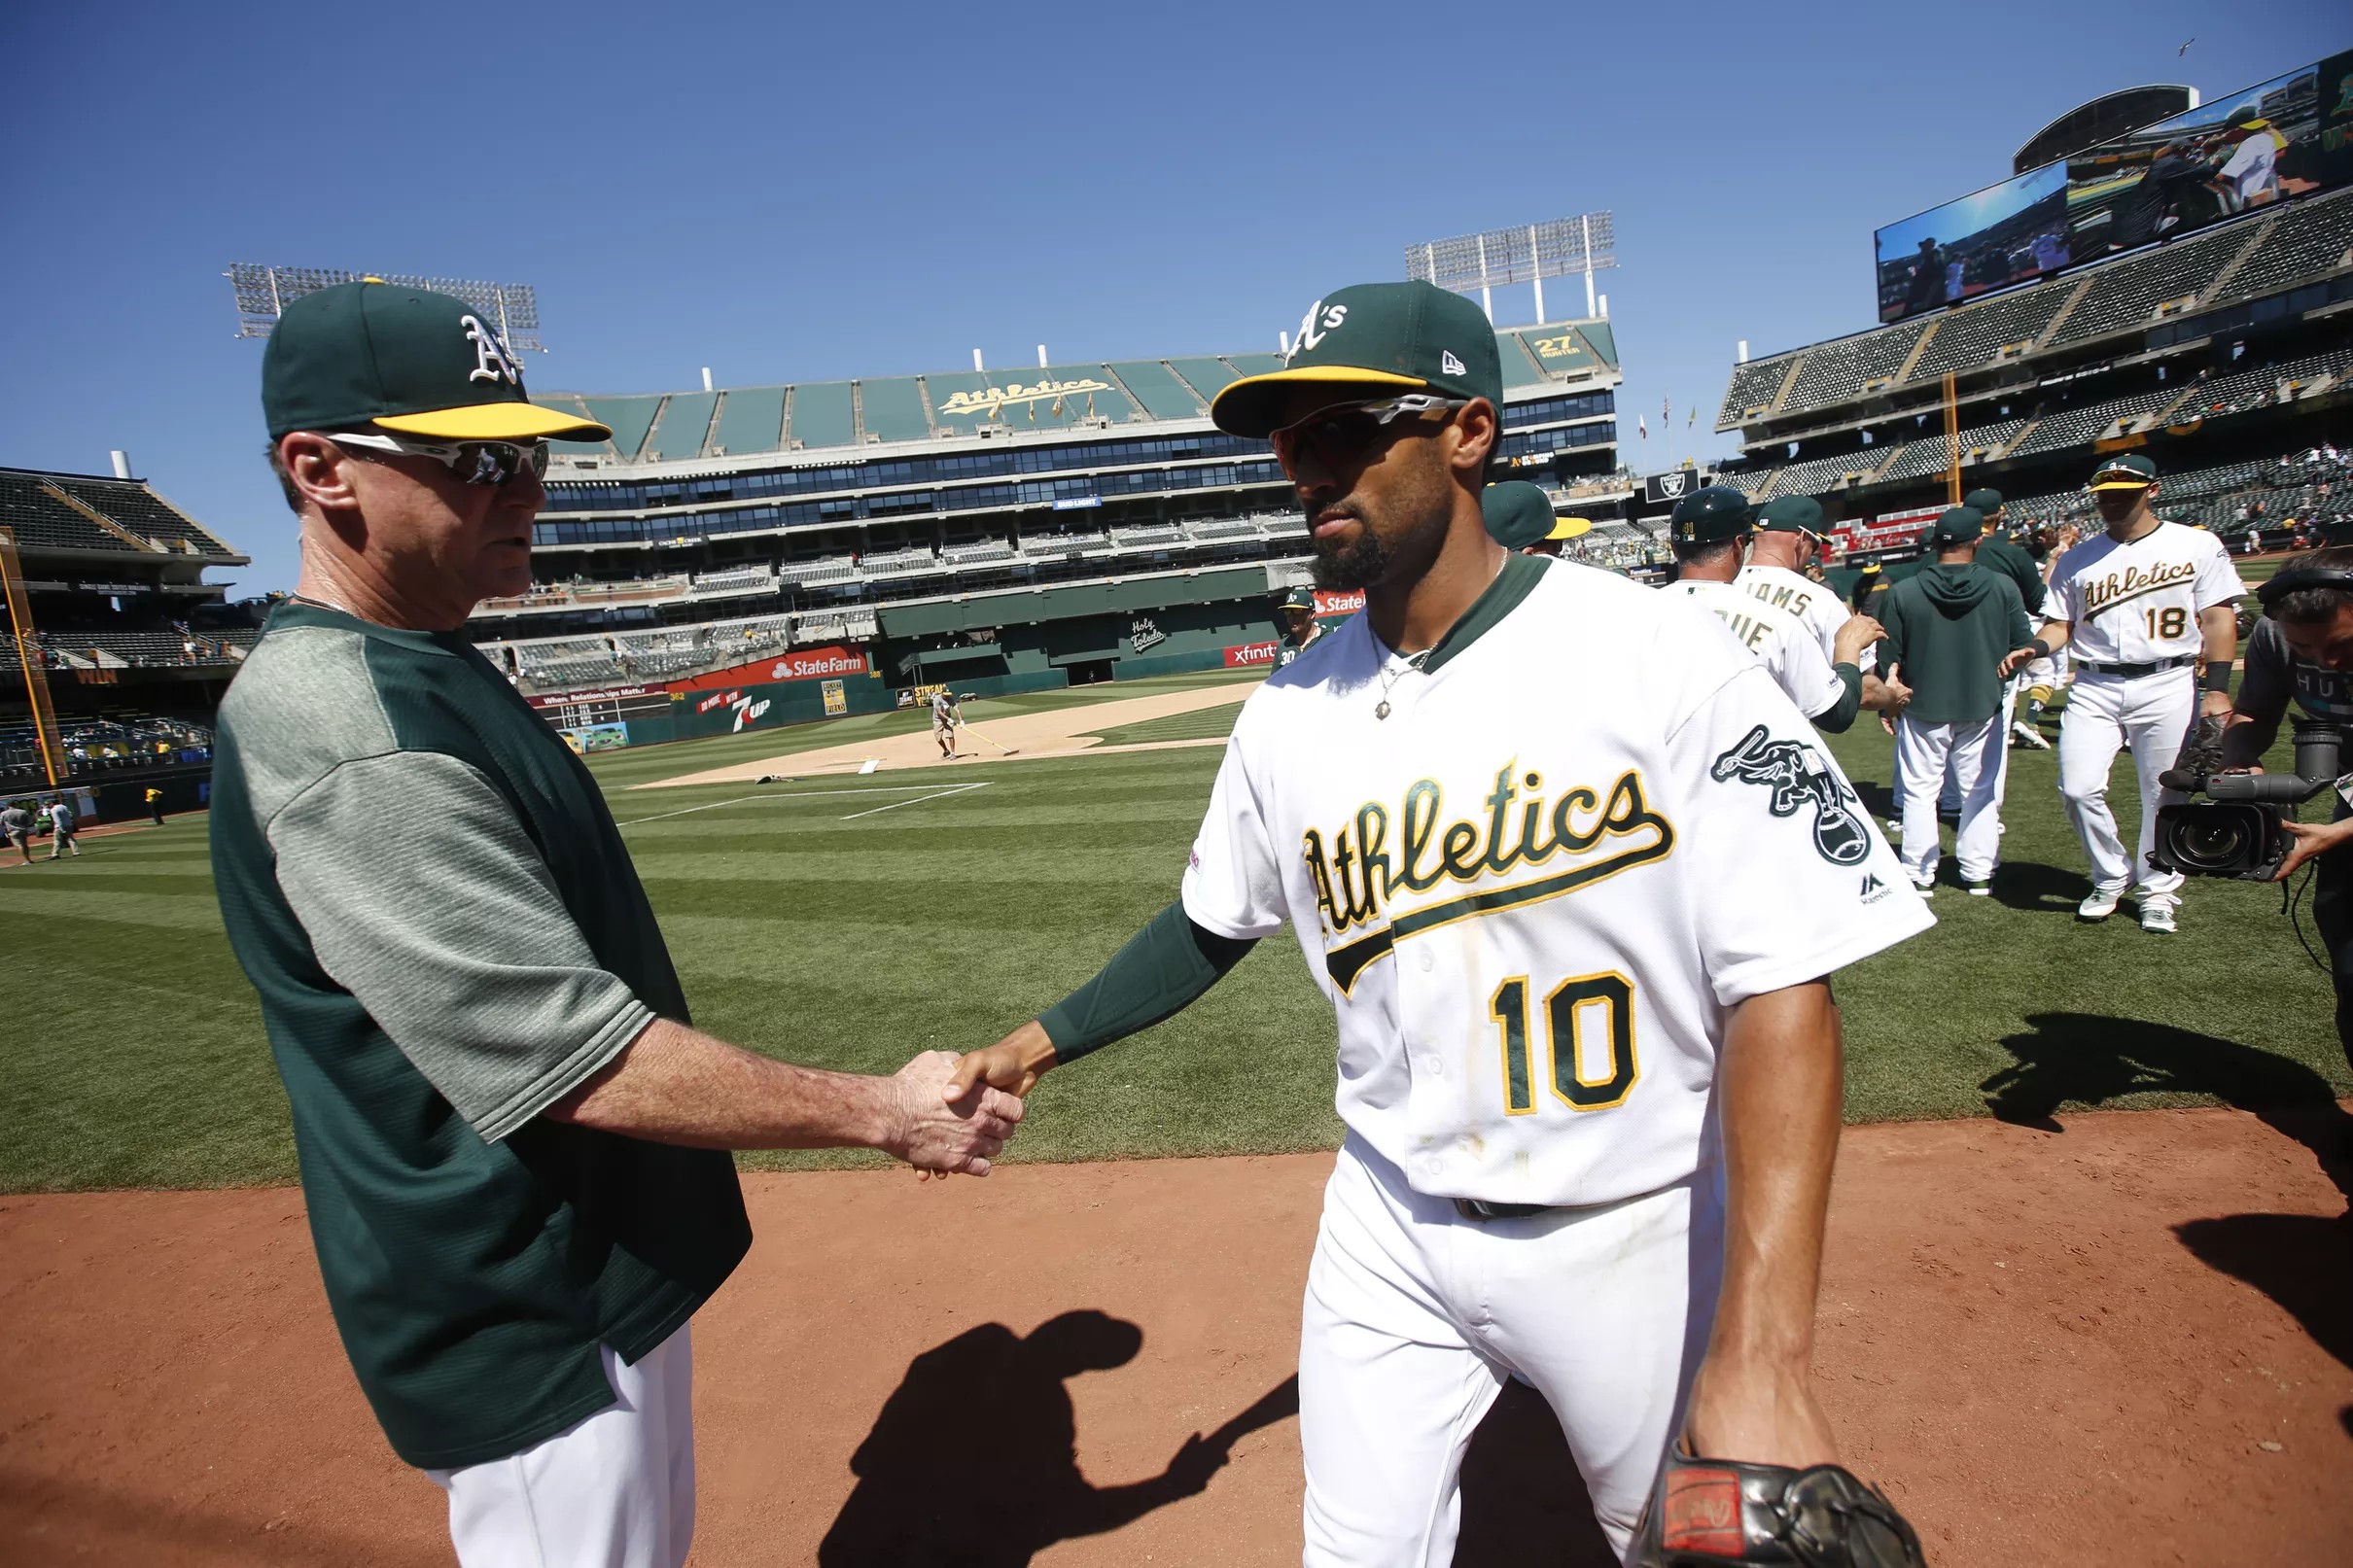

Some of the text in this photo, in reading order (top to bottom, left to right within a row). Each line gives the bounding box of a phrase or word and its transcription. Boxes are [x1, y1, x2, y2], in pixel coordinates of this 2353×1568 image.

[1284, 299, 1349, 367] A's
[1534, 335, 1571, 352] 27
[1541, 347, 1580, 358] HUNTER
[938, 379, 1111, 414] Athletics
[2085, 560, 2195, 613] Athletics
[1326, 594, 1366, 612] State
[1132, 617, 1155, 633] Holy
[2146, 606, 2187, 641] 18
[1130, 628, 1165, 649] Toledo
[1235, 644, 1277, 664] xfinit
[1281, 650, 1295, 666] 30
[869, 670, 882, 679] 388
[670, 692, 685, 701] 362
[826, 704, 845, 713] FIELD
[1302, 753, 1677, 939] Athletics
[1860, 887, 1893, 906] Majestic
[1489, 969, 1641, 1116] 10
